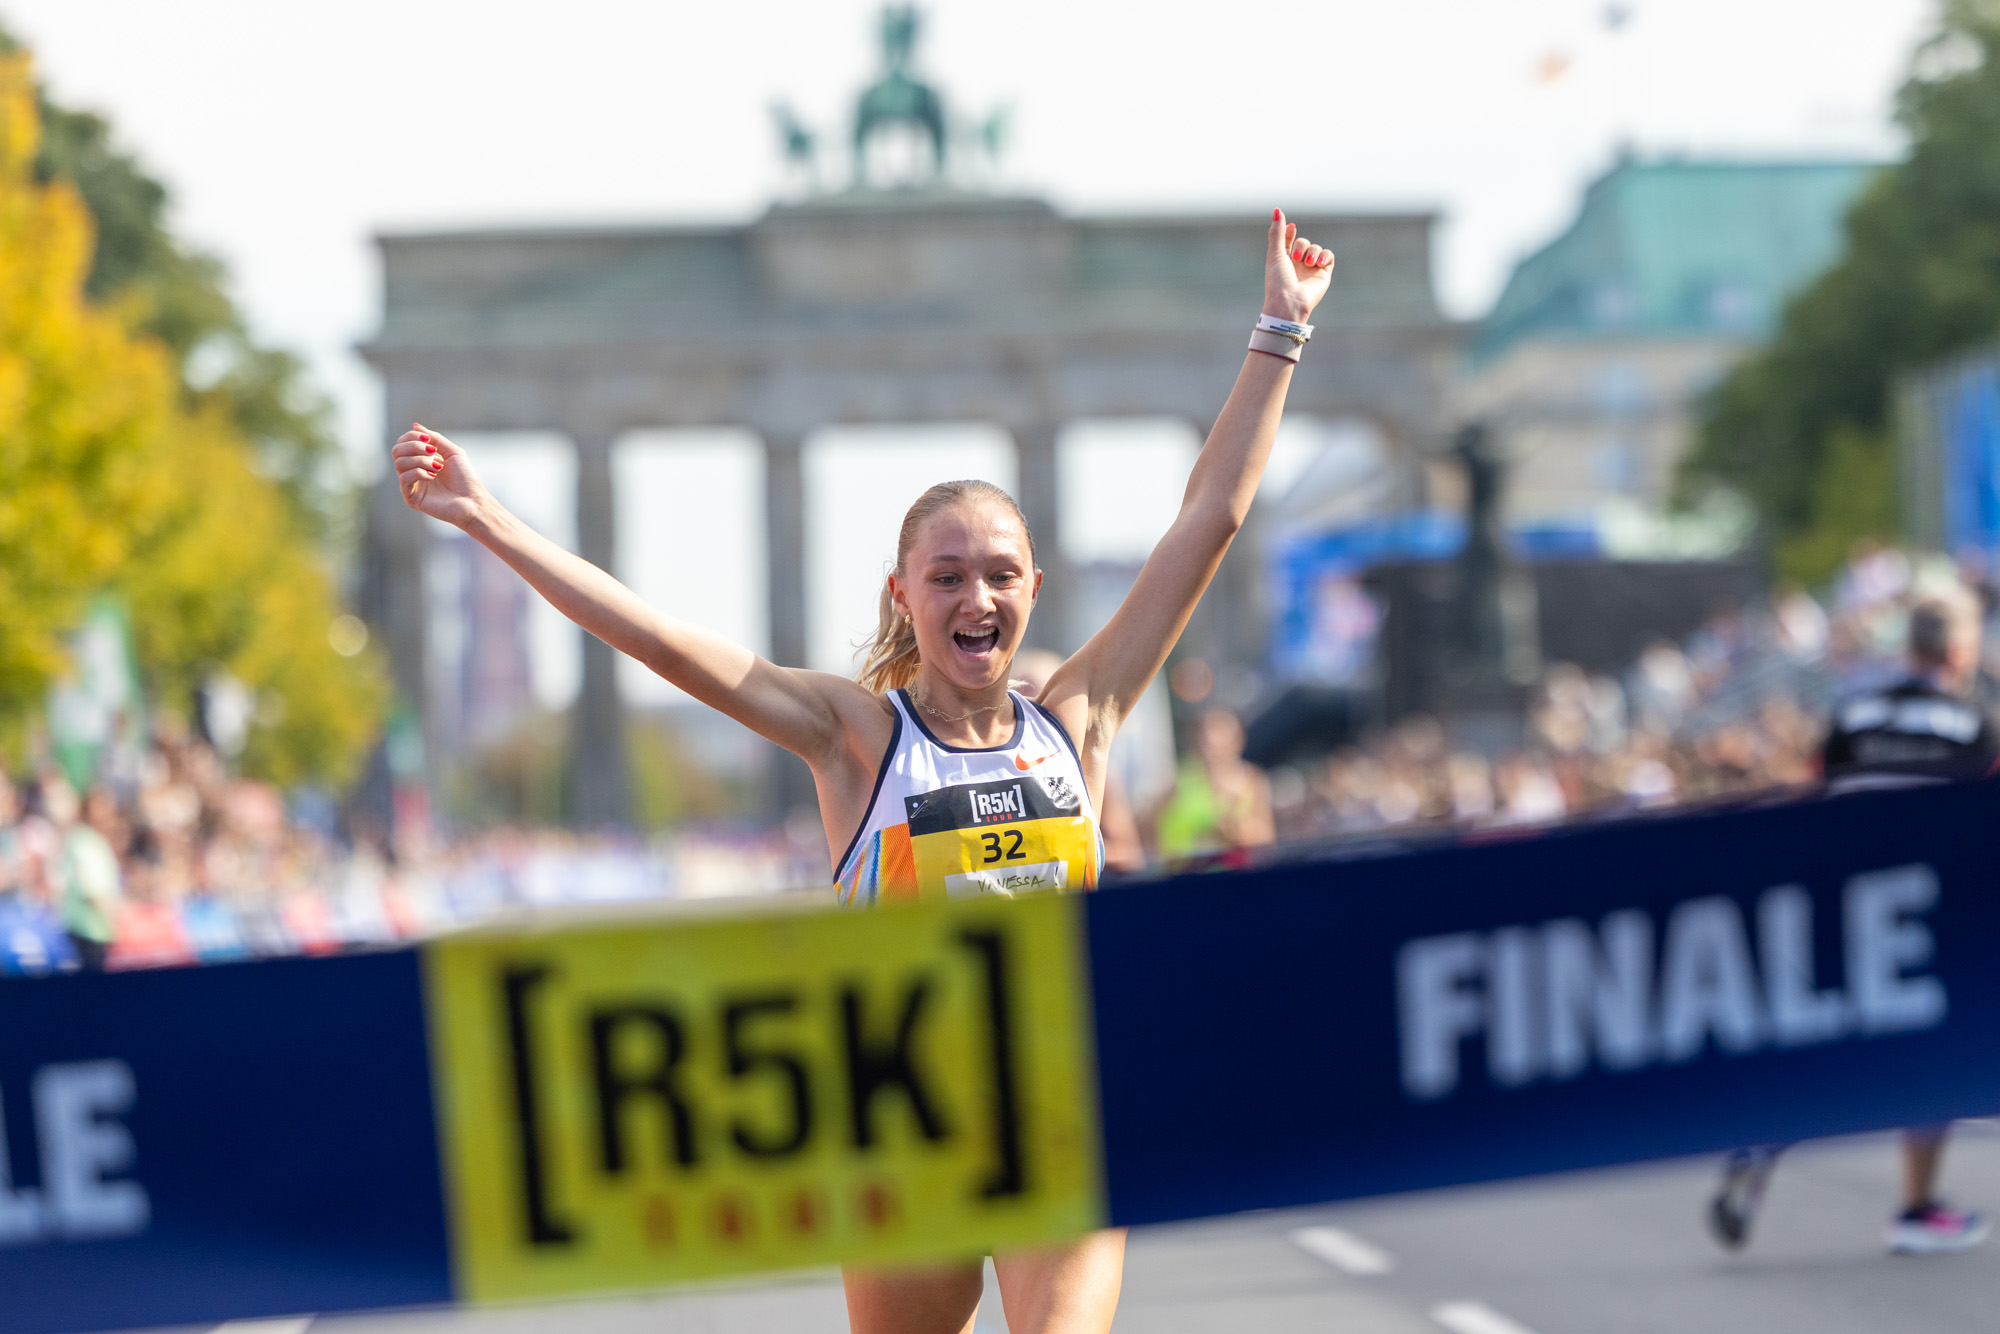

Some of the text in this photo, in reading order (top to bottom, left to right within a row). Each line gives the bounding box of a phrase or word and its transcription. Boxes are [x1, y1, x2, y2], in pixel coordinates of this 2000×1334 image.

[986, 813, 1013, 823] TOUR
[981, 829, 1026, 863] 32
[977, 875, 1045, 892] VANESSA
[1396, 864, 1947, 1097] FINALE
